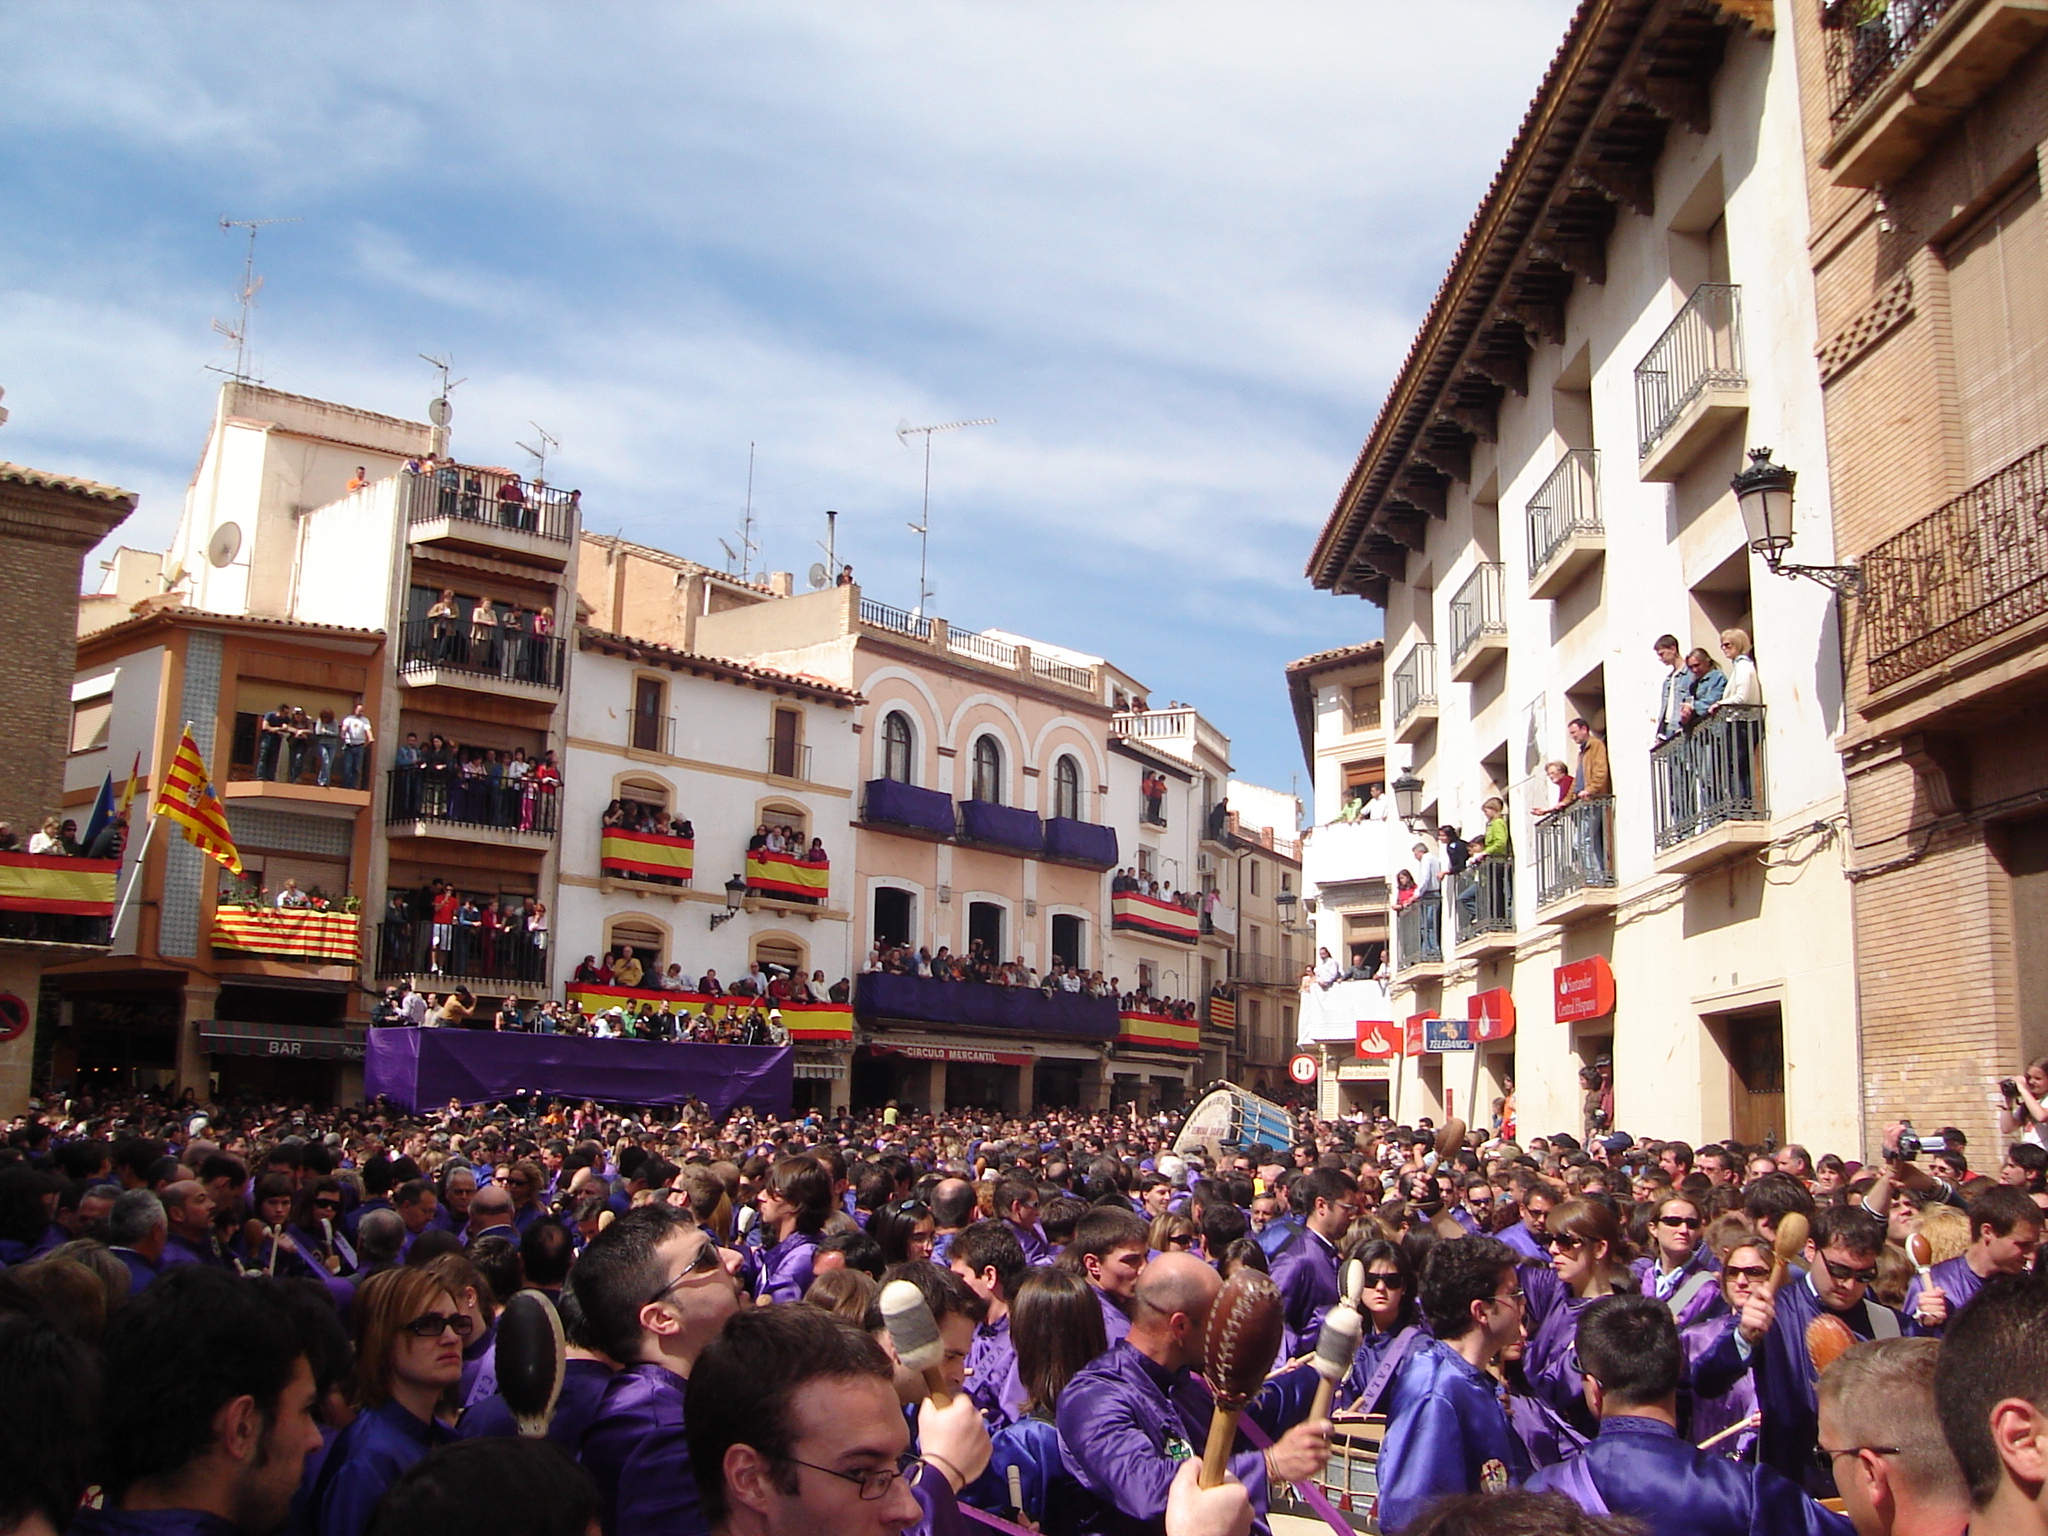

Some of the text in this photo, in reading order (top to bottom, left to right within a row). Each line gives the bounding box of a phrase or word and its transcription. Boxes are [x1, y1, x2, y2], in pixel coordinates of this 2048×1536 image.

[1567, 972, 1592, 993] Santander
[1557, 997, 1597, 1017] Central Hispano
[269, 1041, 301, 1055] BAR
[906, 1047, 997, 1062] CIRCULO MERCANTIL
